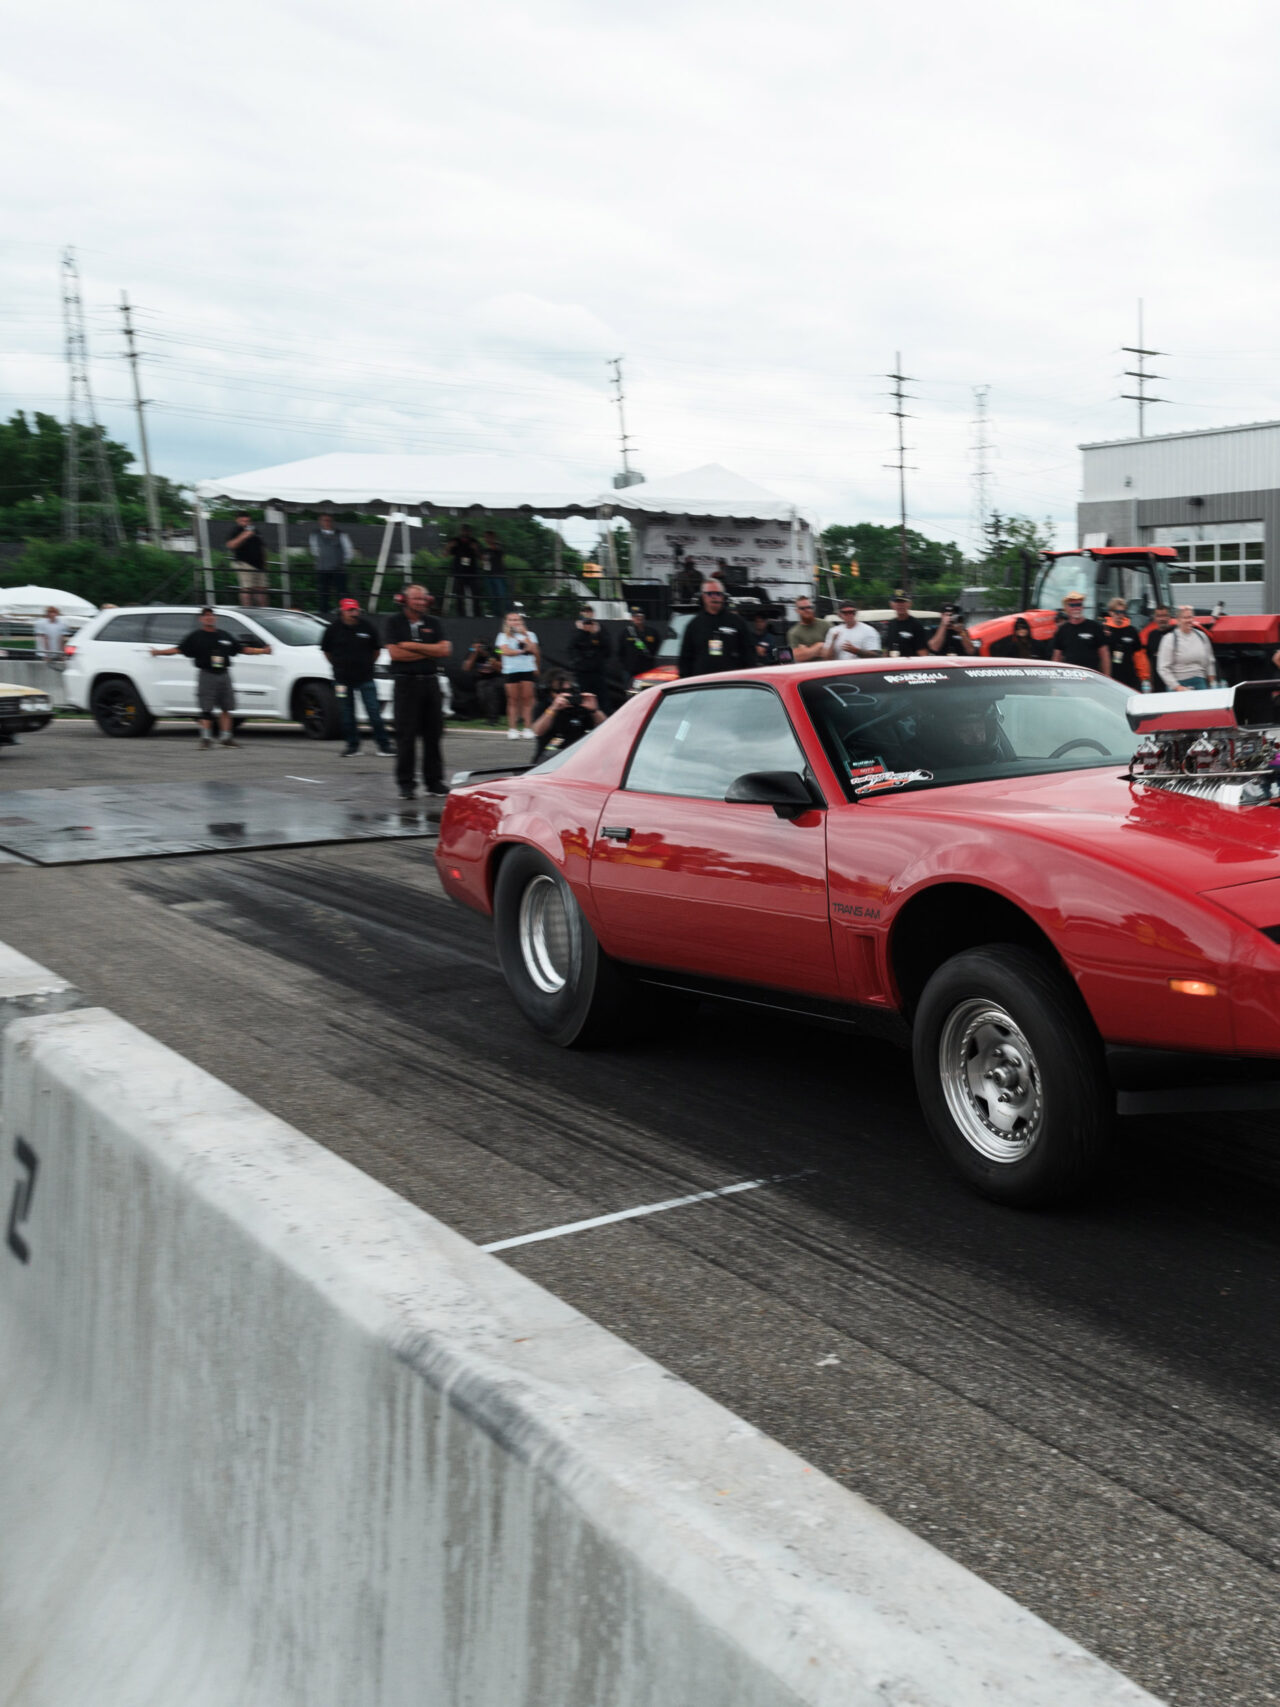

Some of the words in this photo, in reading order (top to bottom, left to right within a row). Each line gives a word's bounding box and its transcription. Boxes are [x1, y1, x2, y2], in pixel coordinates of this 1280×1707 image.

[823, 682, 878, 707] B
[832, 902, 864, 917] TRANS
[863, 907, 881, 920] AM
